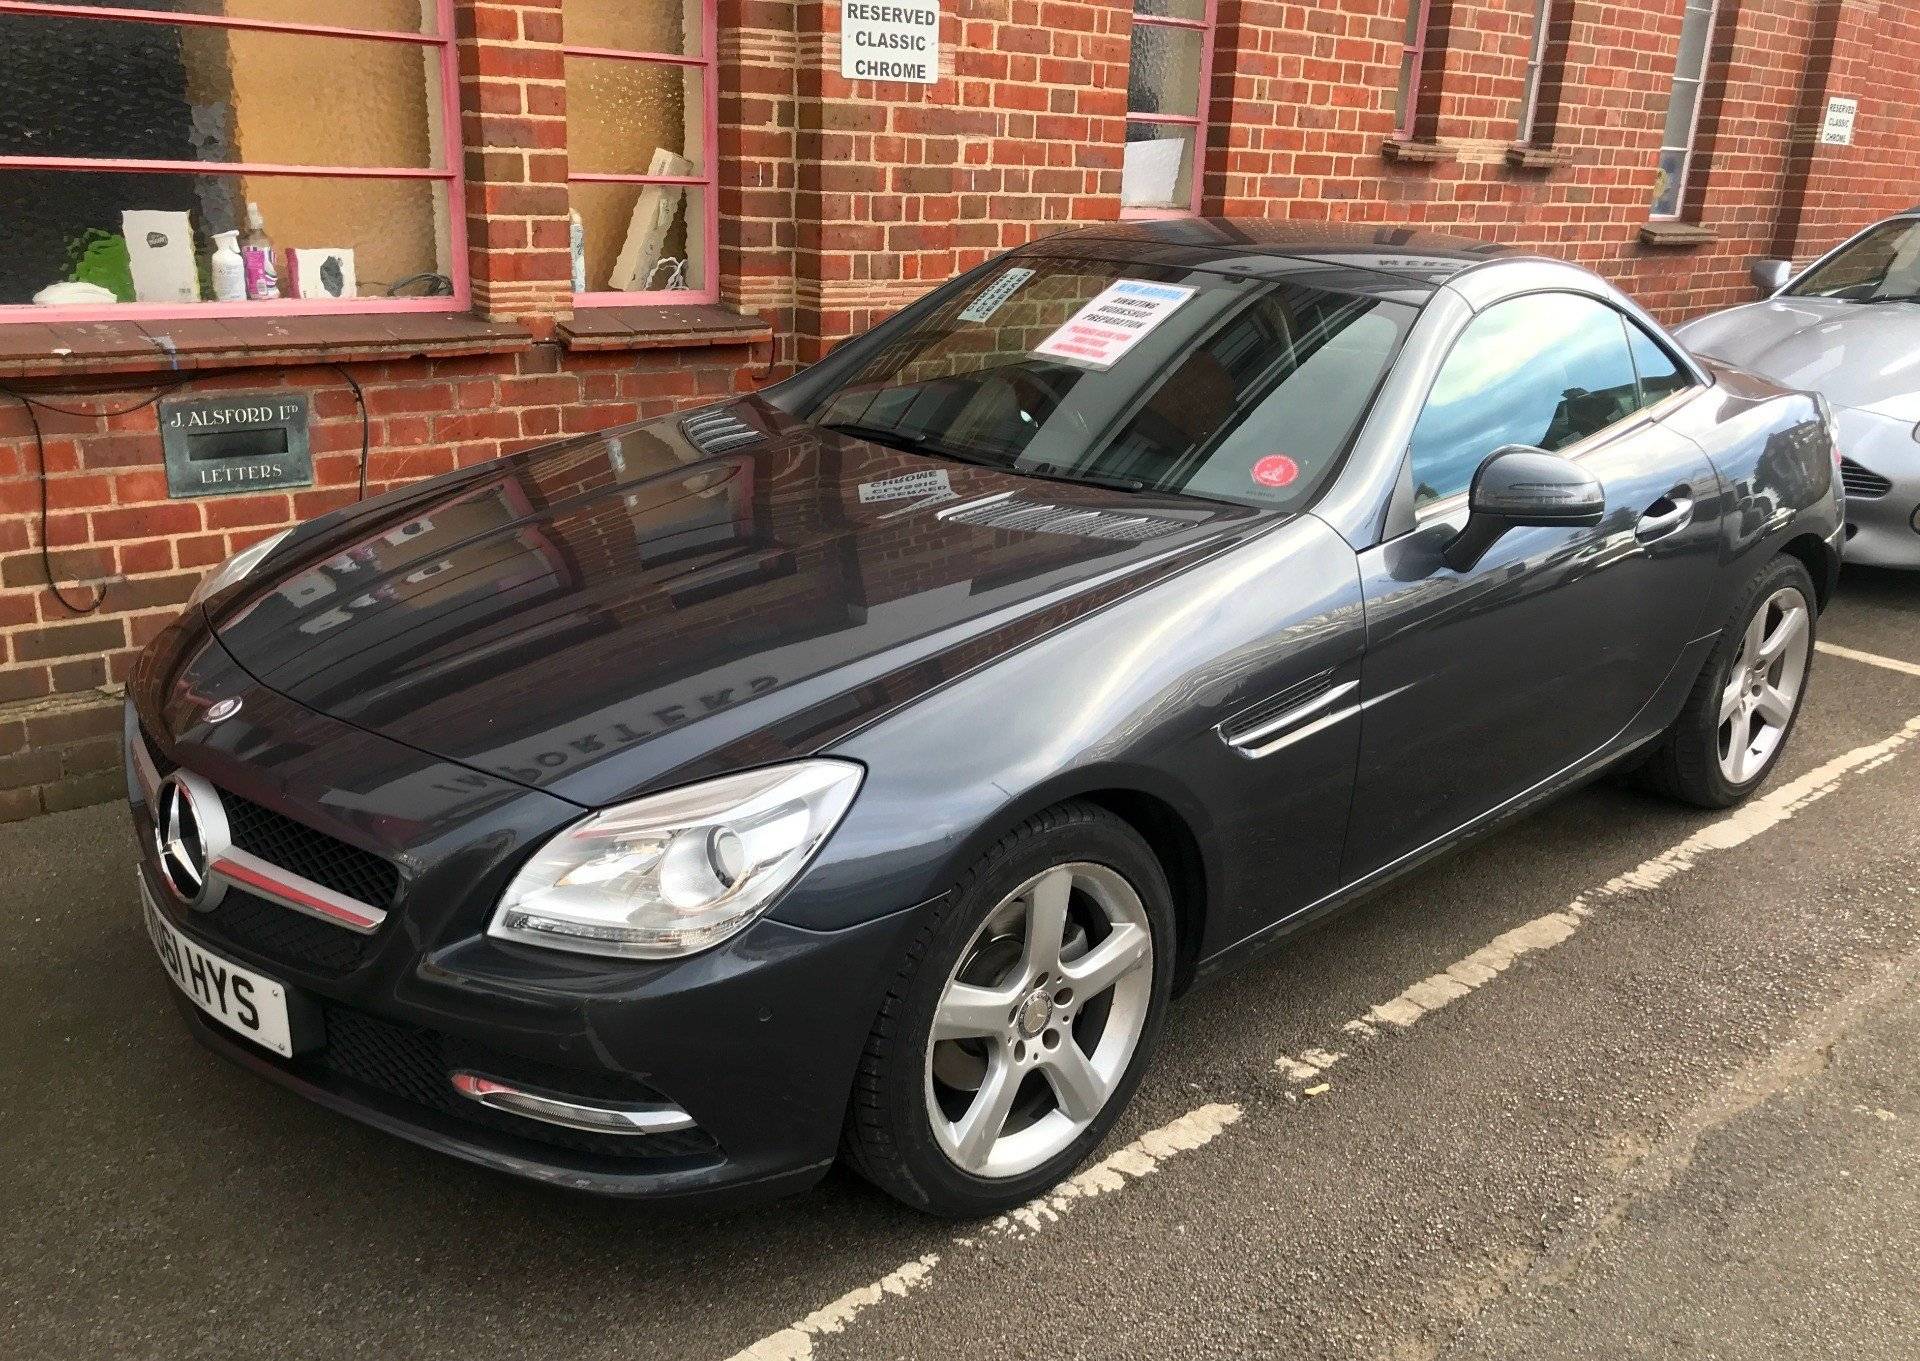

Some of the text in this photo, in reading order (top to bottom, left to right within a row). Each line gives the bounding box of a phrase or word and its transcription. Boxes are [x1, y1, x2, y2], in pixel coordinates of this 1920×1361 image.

[847, 3, 936, 26] RESERVED
[855, 30, 926, 51] CLASSIC
[855, 60, 926, 79] CHROME
[1829, 103, 1854, 115] RESERVED
[1829, 118, 1850, 128] CLASSIC
[1825, 132, 1847, 143] CHROME
[1098, 304, 1153, 319] WORKSHOP
[1110, 296, 1160, 310] AWAITING
[1082, 312, 1147, 330] PREPARATION
[170, 412, 185, 428] J.
[188, 406, 273, 427] ALSFORD
[201, 463, 283, 484] LETTERS
[185, 945, 260, 1031] HYS
